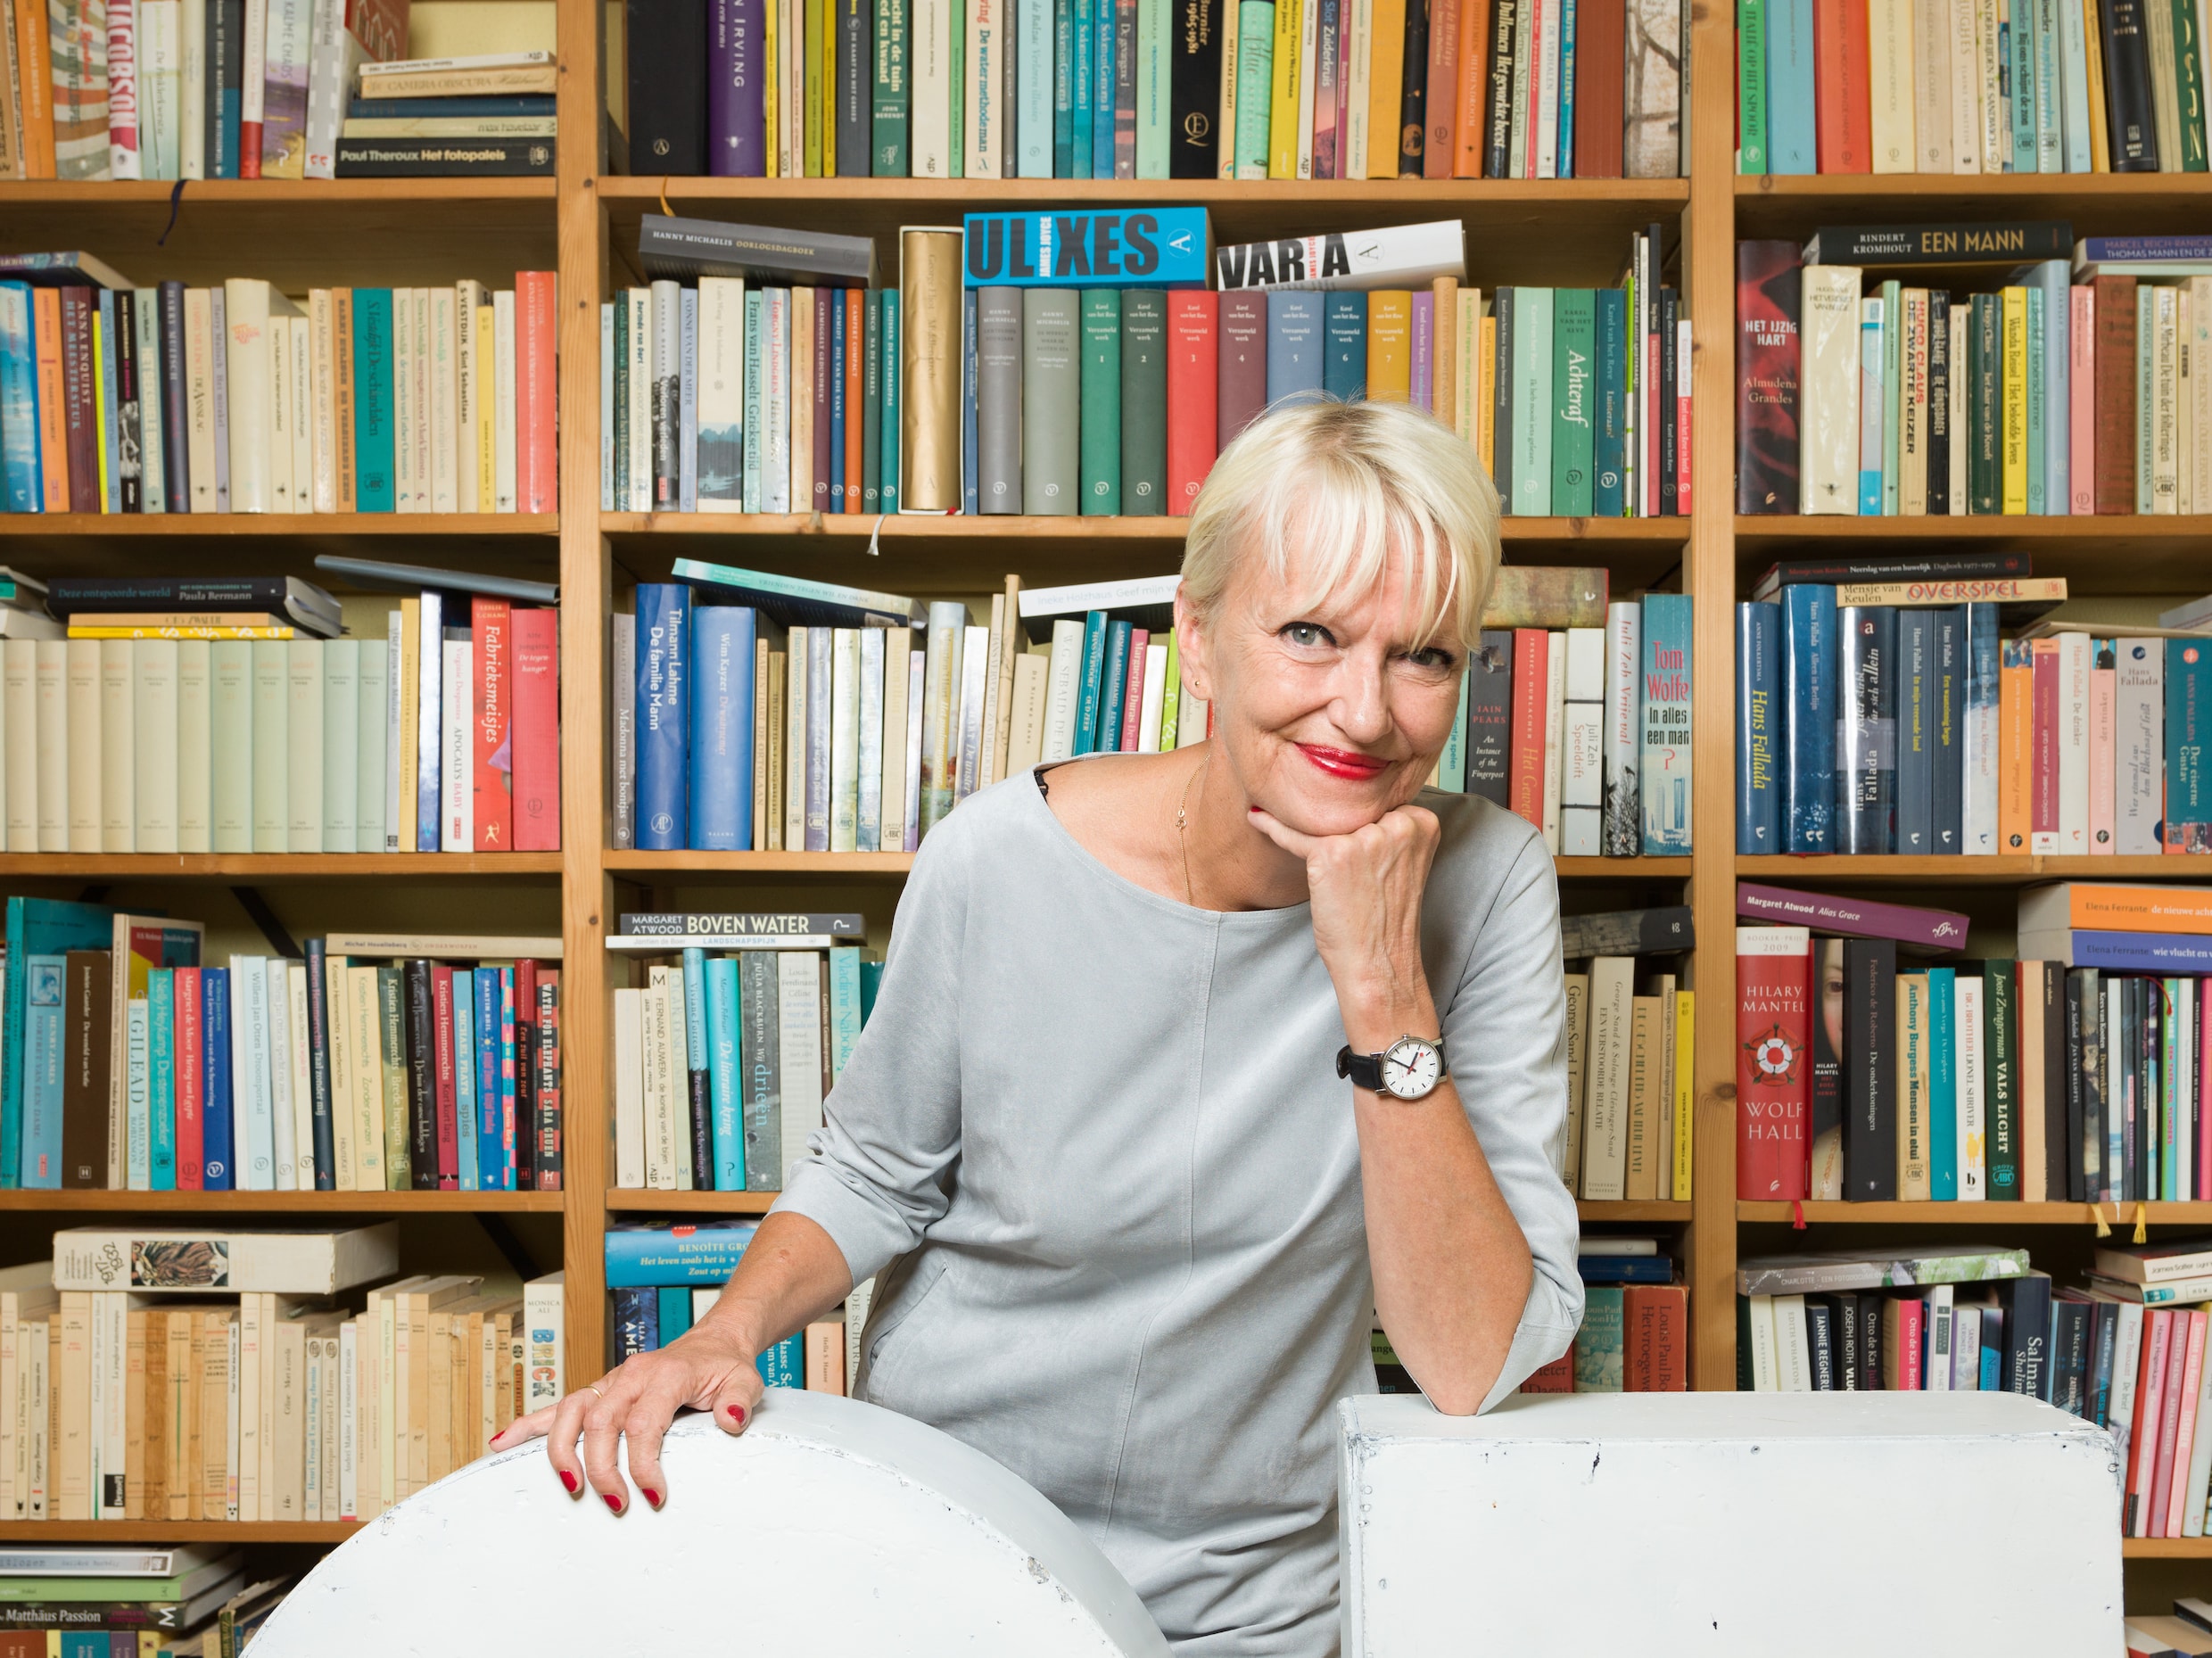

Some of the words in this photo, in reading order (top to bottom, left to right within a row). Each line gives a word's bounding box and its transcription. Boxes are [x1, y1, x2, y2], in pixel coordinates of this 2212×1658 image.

[1324, 2, 1335, 22] Slot
[978, 29, 990, 45] De
[1497, 2, 1515, 54] Dullemen
[107, 4, 136, 128] JACOBSON
[281, 43, 293, 79] CHAOS
[734, 19, 747, 87] IRVING
[879, 41, 890, 84] kwaad
[891, 45, 903, 62] de
[1321, 26, 1335, 87] Zuiderkruis
[891, 66, 903, 92] tuin
[341, 149, 367, 161] Paul
[369, 149, 419, 161] Theroux
[421, 149, 443, 161] Het
[444, 149, 507, 162] fotopaleis
[652, 230, 684, 241] HANNY
[685, 234, 733, 247] MICHAELIS
[736, 239, 815, 256] OORLOGSDAGBOEK
[1853, 243, 1912, 255] KROMHOUT
[1859, 233, 1905, 244] RINDERT
[1920, 231, 1957, 253] EEN
[1964, 229, 2024, 252] MANN
[78, 301, 88, 340] ANNA
[749, 301, 760, 332] Frans
[772, 300, 782, 339] TORGNY
[1746, 321, 1767, 334] HET
[1769, 321, 1797, 334] IJZIG
[1915, 301, 1925, 345] HUGO
[1756, 334, 1787, 346] HART
[2009, 317, 2021, 349] Wanda
[772, 342, 782, 393] LINDGREN
[1293, 354, 1299, 363] 5
[1342, 354, 1349, 362] 6
[1906, 326, 1916, 393] ZWARTE
[80, 344, 91, 405] ENQUIST
[748, 358, 760, 399] Hasselt
[1561, 350, 1588, 427] Achteraf
[1743, 378, 1798, 390] Almudena
[1915, 351, 1925, 404] CLAUS
[460, 371, 469, 425] Sebastiaan
[658, 379, 669, 419] Verloren
[1747, 392, 1794, 404] Grandes
[747, 404, 760, 450] Griekse
[1906, 396, 1916, 455] KEIZER
[2009, 403, 2020, 441] beloofde
[658, 421, 669, 461] verleden
[747, 451, 760, 471] tijd
[178, 590, 206, 601] Paula
[208, 590, 252, 601] Bermann
[1844, 583, 1879, 596] Mensje
[1883, 583, 1902, 593] van
[1845, 592, 1882, 604] Keulen
[1907, 581, 2023, 604] OVERSPEL
[649, 627, 663, 646] De
[668, 608, 682, 659] Tilmann
[719, 633, 730, 656] Wim
[1617, 620, 1633, 646] Juli
[649, 649, 664, 691] familie
[1130, 642, 1145, 693] Marguerite
[1620, 652, 1633, 678] Zeh
[1654, 640, 1684, 670] Tom
[482, 624, 501, 744] Fabrieksmeisjes
[668, 662, 682, 705] Lahme
[717, 659, 730, 692] Kayzer
[1647, 673, 1690, 702] Wolfe
[648, 694, 663, 730] Mann
[1127, 695, 1142, 723] Duras
[1617, 686, 1632, 717] Vrije
[1662, 707, 1688, 723] alles
[1752, 690, 1767, 730] Hans
[2073, 703, 2083, 714] De
[619, 708, 630, 758] Madonna
[1473, 715, 1506, 724] PEARS
[1586, 723, 1598, 742] Juli
[2073, 715, 2083, 747] drinker
[1475, 747, 1501, 755] Instance
[1483, 735, 1495, 743] An
[1572, 724, 1585, 779] Speeldrift
[1669, 730, 1689, 745] man
[1478, 761, 1486, 769] of
[1487, 760, 1498, 768] the
[1588, 745, 1598, 766] Zeh
[1753, 734, 1771, 789] Fallada
[2179, 746, 2190, 784] Gustav
[2190, 746, 2200, 766] Der
[1471, 770, 1505, 780] Fingerpost
[1864, 750, 1877, 802] Fallada
[2190, 769, 2200, 807] eiserne
[453, 782, 463, 810] BABY
[616, 782, 630, 819] bontjas
[631, 916, 682, 925] MARGARET
[1746, 895, 1782, 911] Margaret
[1783, 901, 1815, 915] Atwood
[1818, 905, 1837, 918] Alias
[1838, 910, 1861, 922] Grace
[631, 925, 682, 935] ATWOOD
[687, 915, 746, 934] BOVEN
[750, 915, 810, 934] WATER
[702, 937, 776, 945] LANDSCHAPSPIJN
[2170, 947, 2196, 960] vlucht
[755, 962, 763, 987] JULIA
[1993, 973, 2007, 996] Joost
[183, 975, 194, 1011] Margriet
[439, 980, 450, 1015] Kristien
[541, 983, 552, 1016] WATER
[1743, 1000, 1805, 1013] MANTEL
[1746, 986, 1803, 999] HILARY
[1906, 984, 1919, 1030] Anthony
[542, 1019, 552, 1035] FOR
[755, 990, 764, 1043] BLACKBURN
[1993, 998, 2008, 1059] Zwagerman
[186, 1027, 194, 1051] Moor
[440, 1017, 450, 1080] Hemmerechts
[458, 1009, 468, 1057] MICHAEL
[129, 1019, 145, 1104] GILEAD
[719, 1040, 732, 1060] De
[1597, 1027, 1607, 1089] VERSTOORDE
[1869, 1051, 1878, 1065] De
[1907, 1032, 1919, 1078] Burgess
[458, 1060, 469, 1095] FRAYN
[542, 1039, 553, 1093] ELEPHANTS
[1997, 1061, 2008, 1100] VALS
[315, 1070, 325, 1101] zonder
[721, 1062, 733, 1103] literaire
[755, 1064, 772, 1126] drieën
[543, 1099, 553, 1125] SARA
[1595, 1092, 1605, 1131] RELATIE
[1746, 1101, 1803, 1118] WOLF
[1866, 1067, 1878, 1131] onderkoningen
[1909, 1080, 1919, 1124] Mensen
[459, 1104, 471, 1138] spies
[718, 1106, 735, 1136] kring
[1748, 1124, 1803, 1140] HALL
[1997, 1104, 2009, 1152] LICHT
[543, 1127, 553, 1158] GRUEN
[1641, 1306, 1655, 1329] Het
[1659, 1306, 1671, 1341] Louis
[1816, 1316, 1827, 1348] JANNIE
[1845, 1306, 1854, 1338] JOSEPH
[1867, 1313, 1878, 1335] Otto
[532, 1328, 557, 1398] BRICK
[1637, 1331, 1652, 1374] vroege
[1659, 1344, 1671, 1371] Paul
[1845, 1340, 1853, 1364] ROTH
[1868, 1350, 1878, 1366] Kat
[5, 1609, 57, 1621] Matthäus
[59, 1609, 102, 1622] Passion
